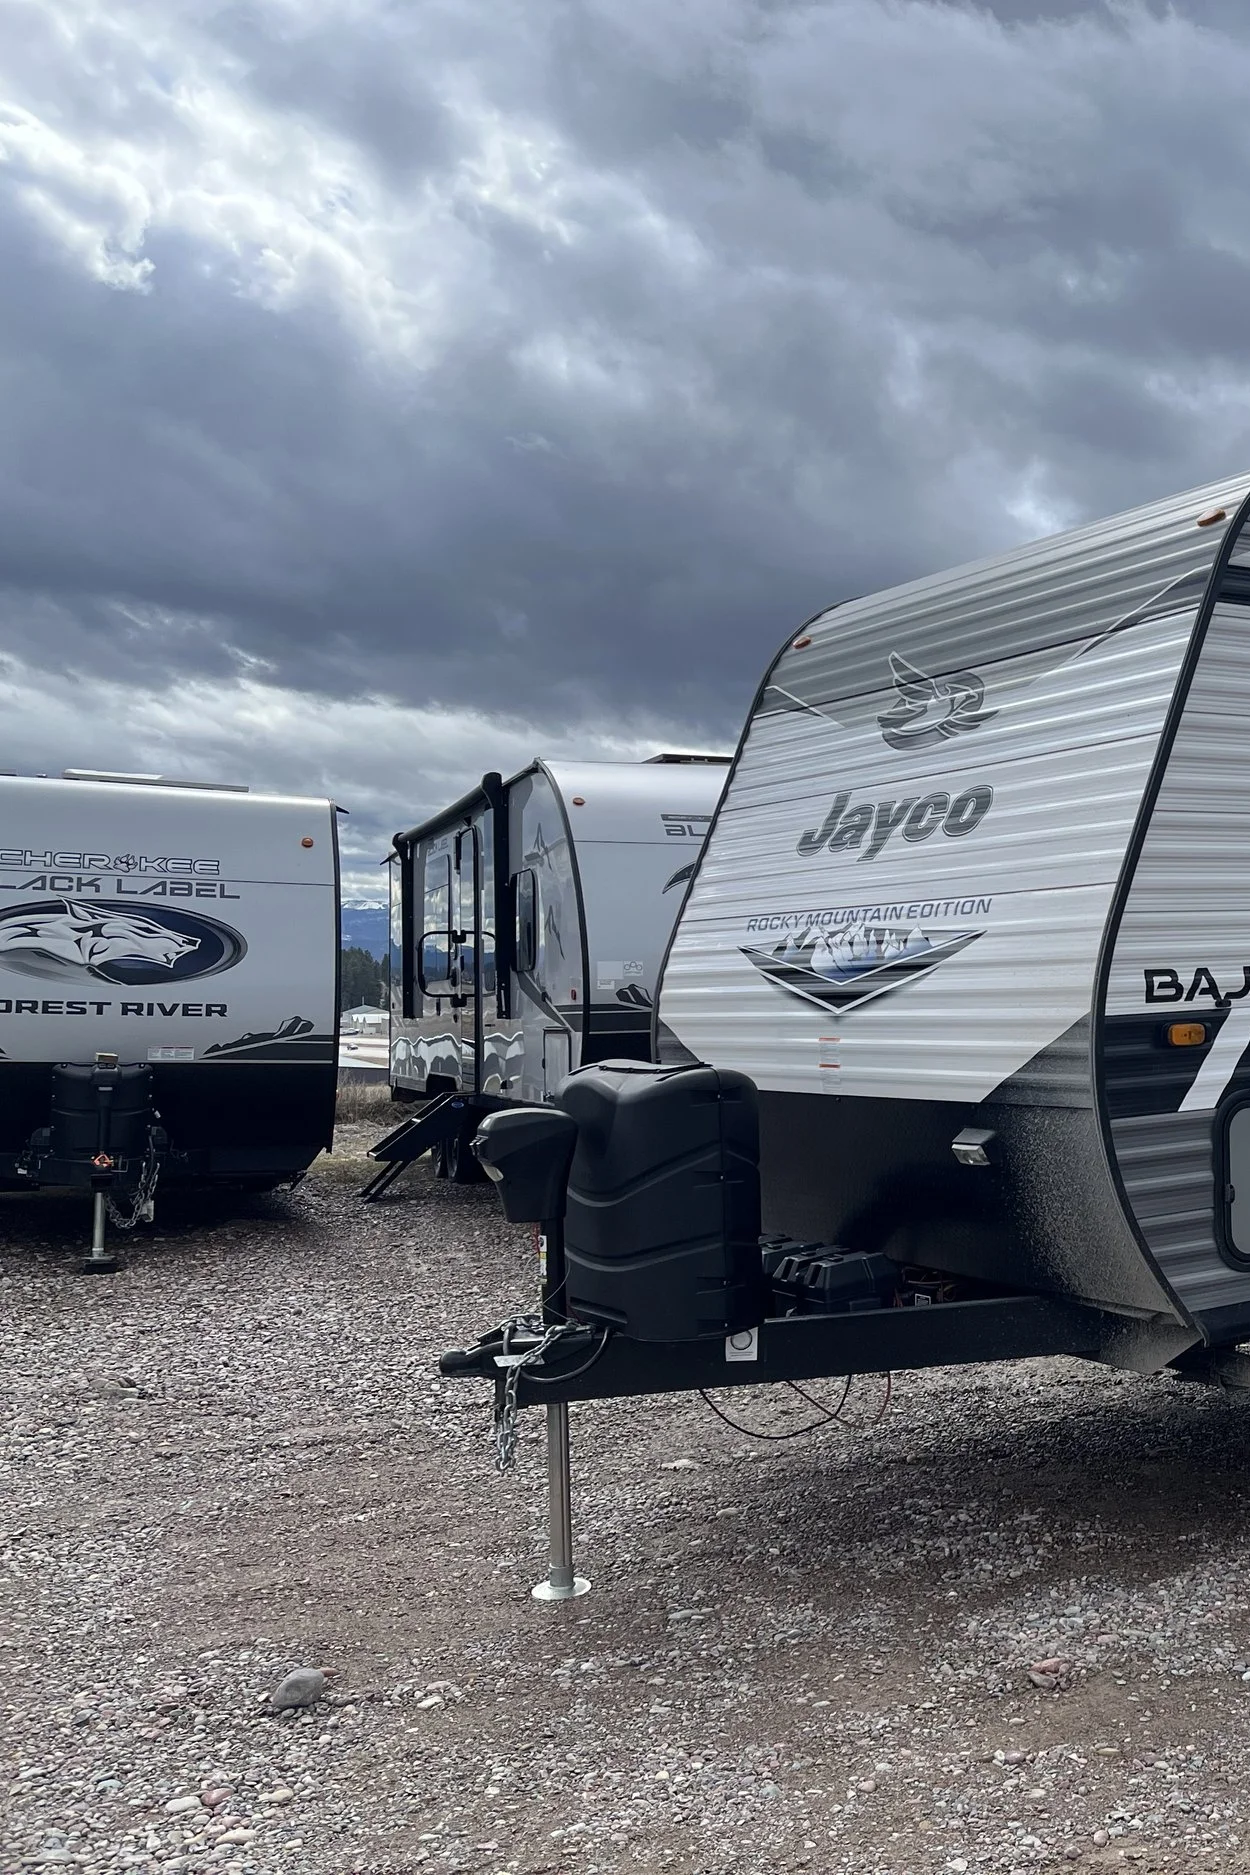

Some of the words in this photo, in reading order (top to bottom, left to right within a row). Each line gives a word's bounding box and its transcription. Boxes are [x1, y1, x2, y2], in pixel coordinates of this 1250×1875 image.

[796, 785, 995, 863] Jayco
[116, 879, 241, 900] LABEL
[747, 914, 803, 933] ROCKY
[805, 904, 907, 928] MOUNTAIN
[907, 898, 993, 920] EDITION
[120, 1001, 228, 1018] RIVER
